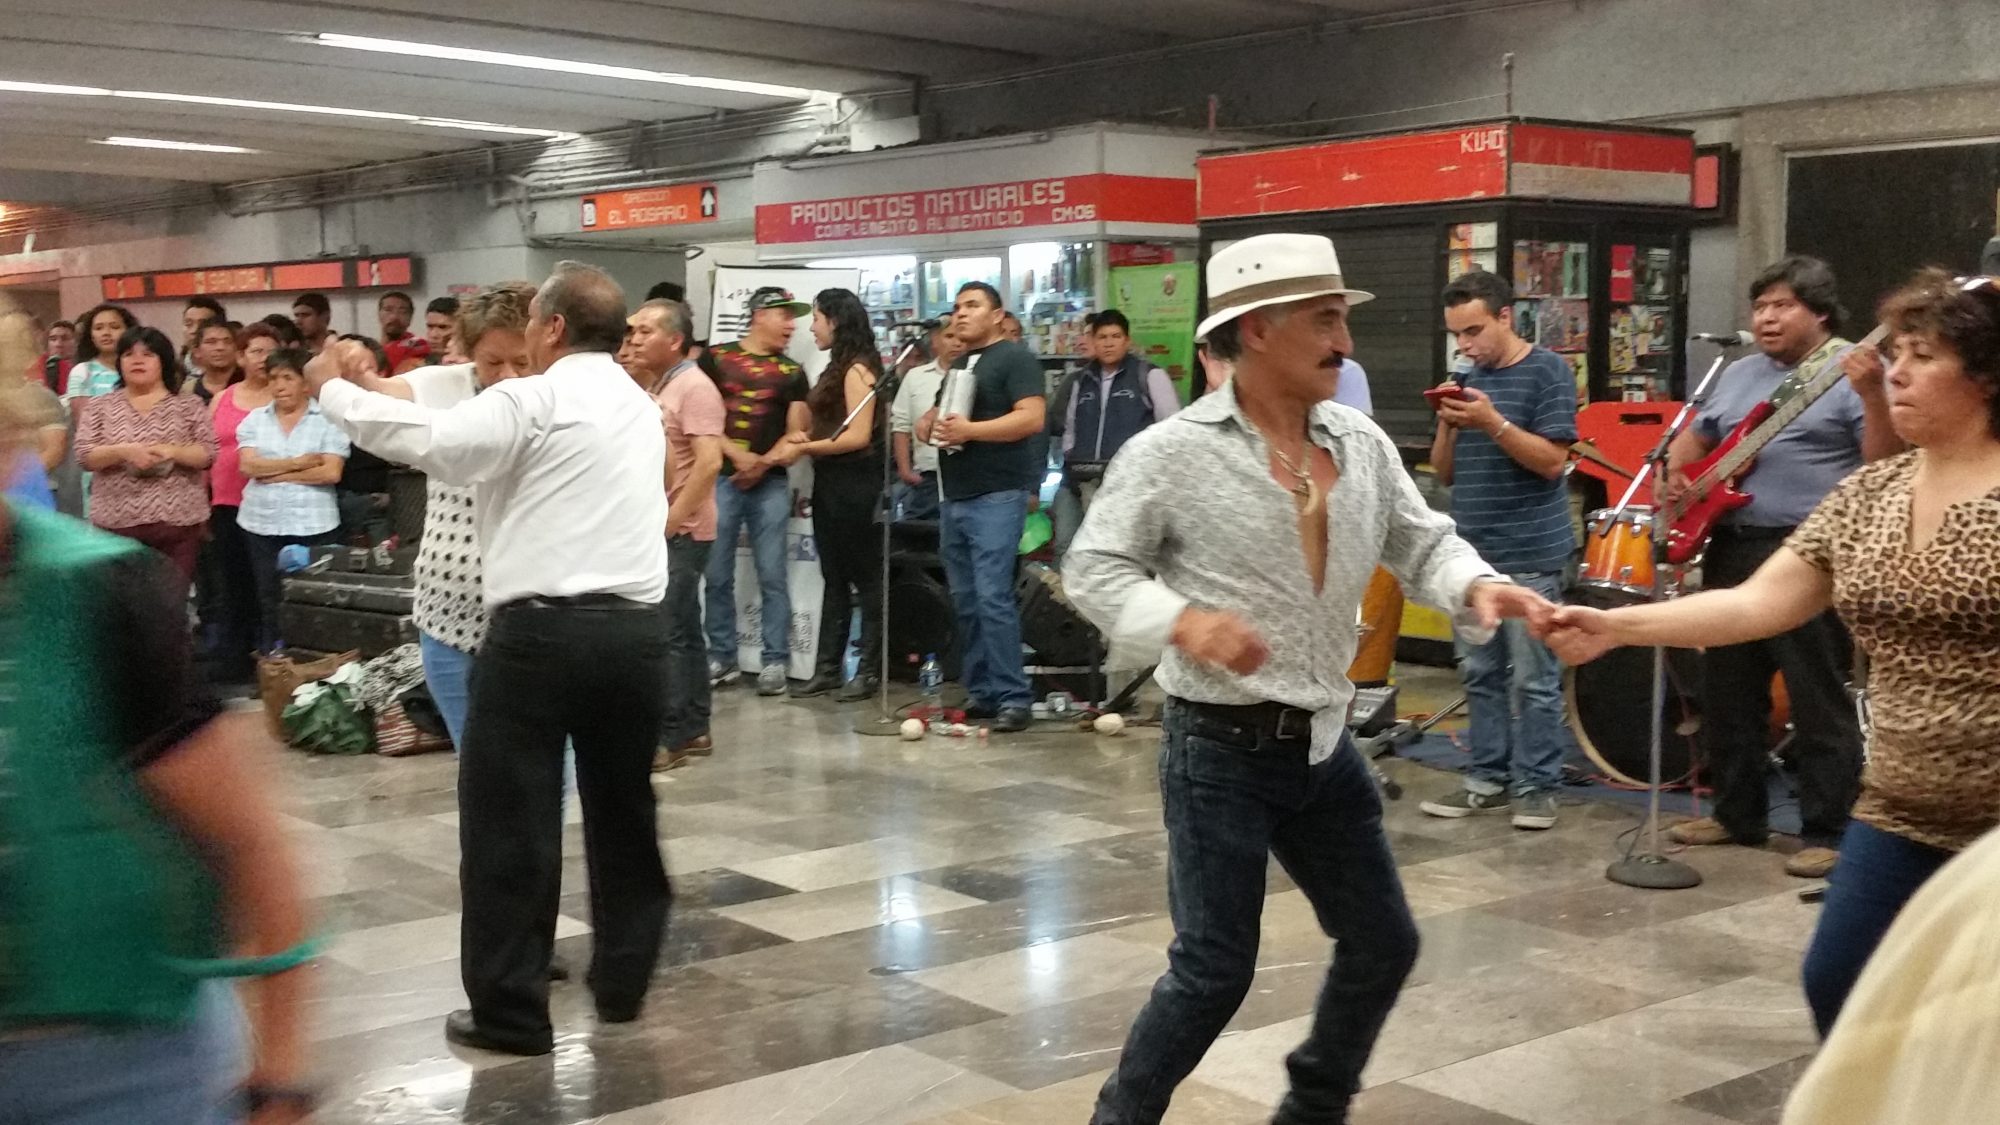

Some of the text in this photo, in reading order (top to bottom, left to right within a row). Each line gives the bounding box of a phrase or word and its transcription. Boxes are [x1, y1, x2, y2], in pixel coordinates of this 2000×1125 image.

[628, 204, 688, 223] ROSARIO
[791, 181, 1065, 225] PRODUCTOS NATURALES
[815, 210, 1024, 238] COMPLEMENTO ALIMENTICIO
